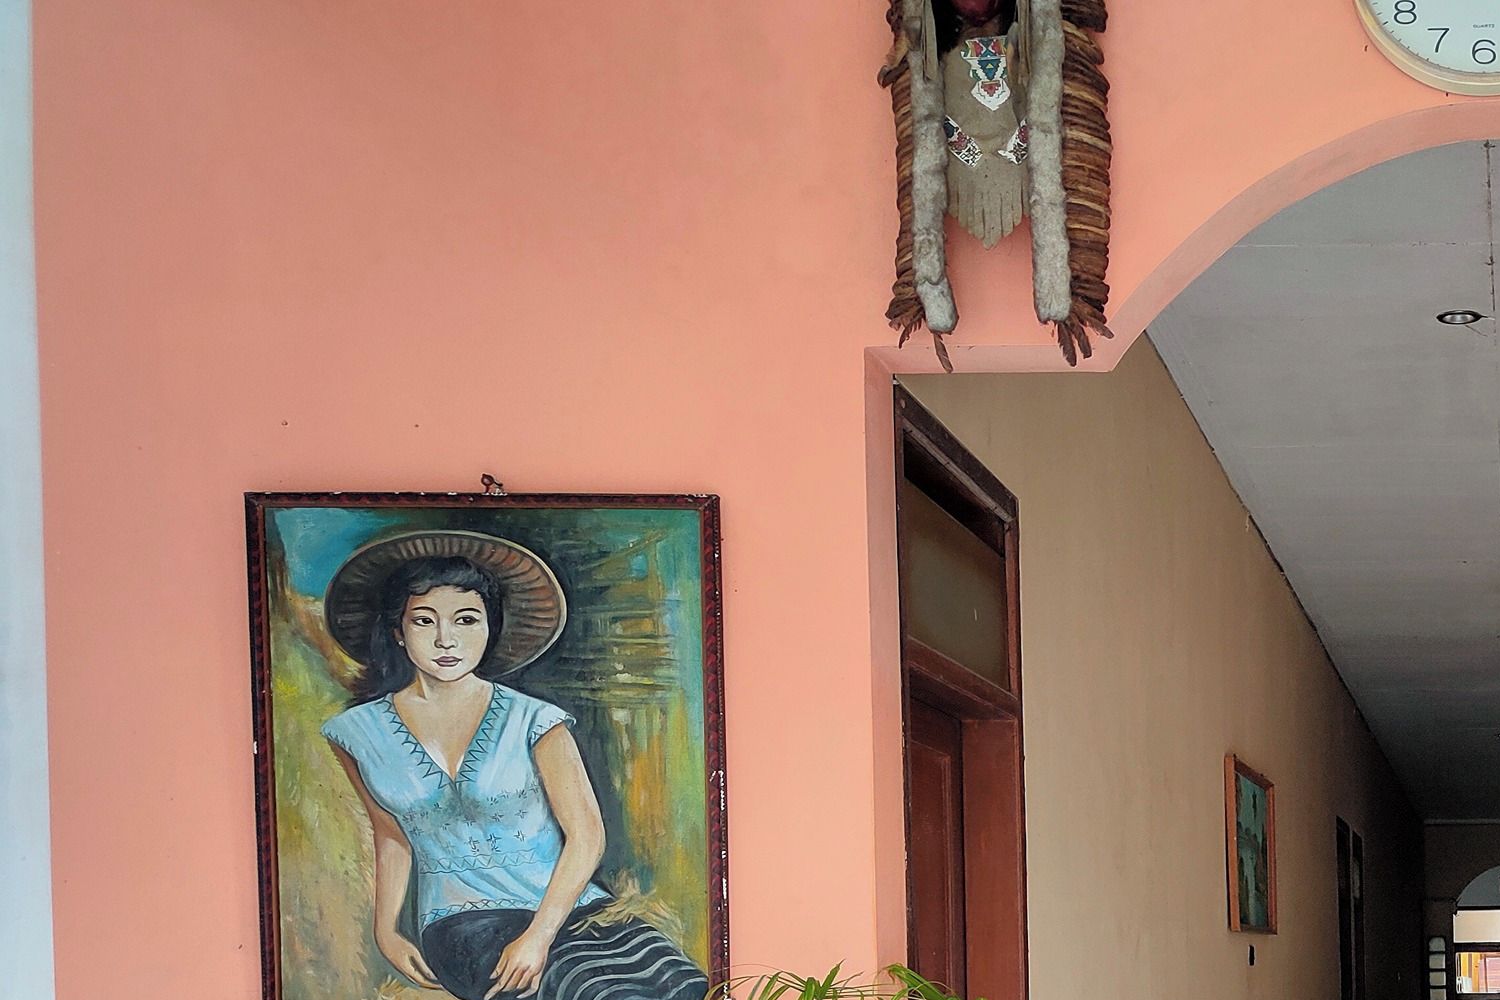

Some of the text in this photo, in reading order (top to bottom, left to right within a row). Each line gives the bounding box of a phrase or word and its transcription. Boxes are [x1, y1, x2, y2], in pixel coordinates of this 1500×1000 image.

[1394, 0, 1417, 24] 8
[1427, 28, 1450, 53] 7
[1472, 39, 1496, 64] 6
